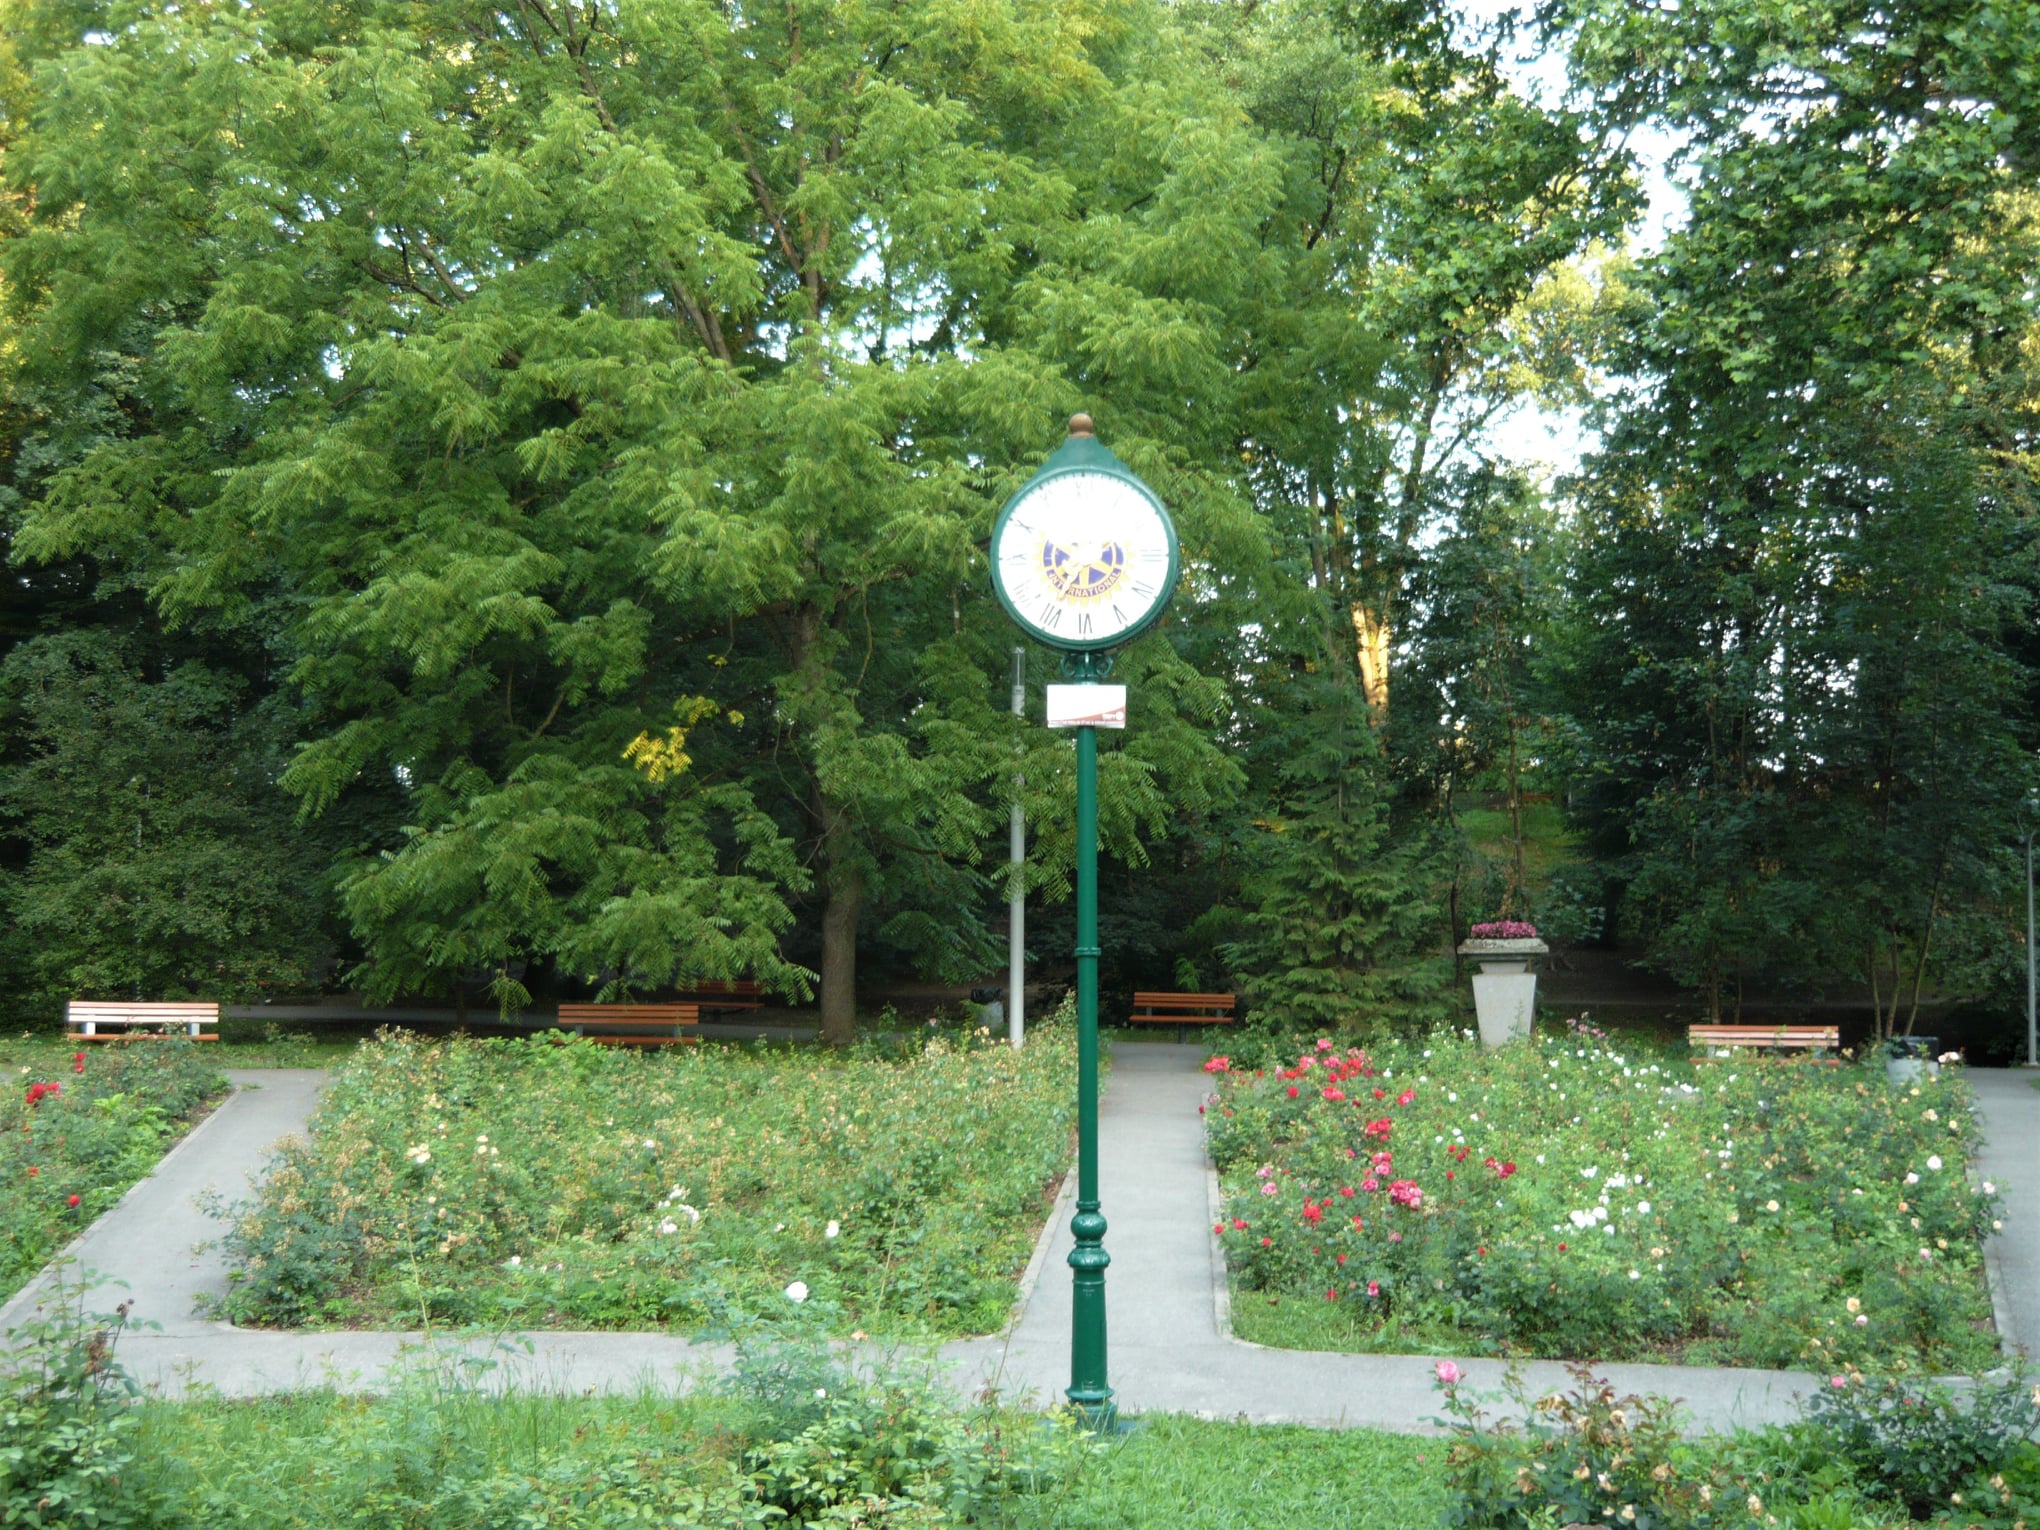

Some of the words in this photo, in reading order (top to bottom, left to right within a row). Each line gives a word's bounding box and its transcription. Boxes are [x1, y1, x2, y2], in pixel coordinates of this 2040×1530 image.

[1140, 549, 1163, 562] III
[1047, 569, 1122, 598] INTRNATIONAL
[1131, 580, 1155, 600] IV
[1039, 602, 1062, 629] VII
[1078, 612, 1093, 635] VI
[1112, 603, 1128, 626] V
